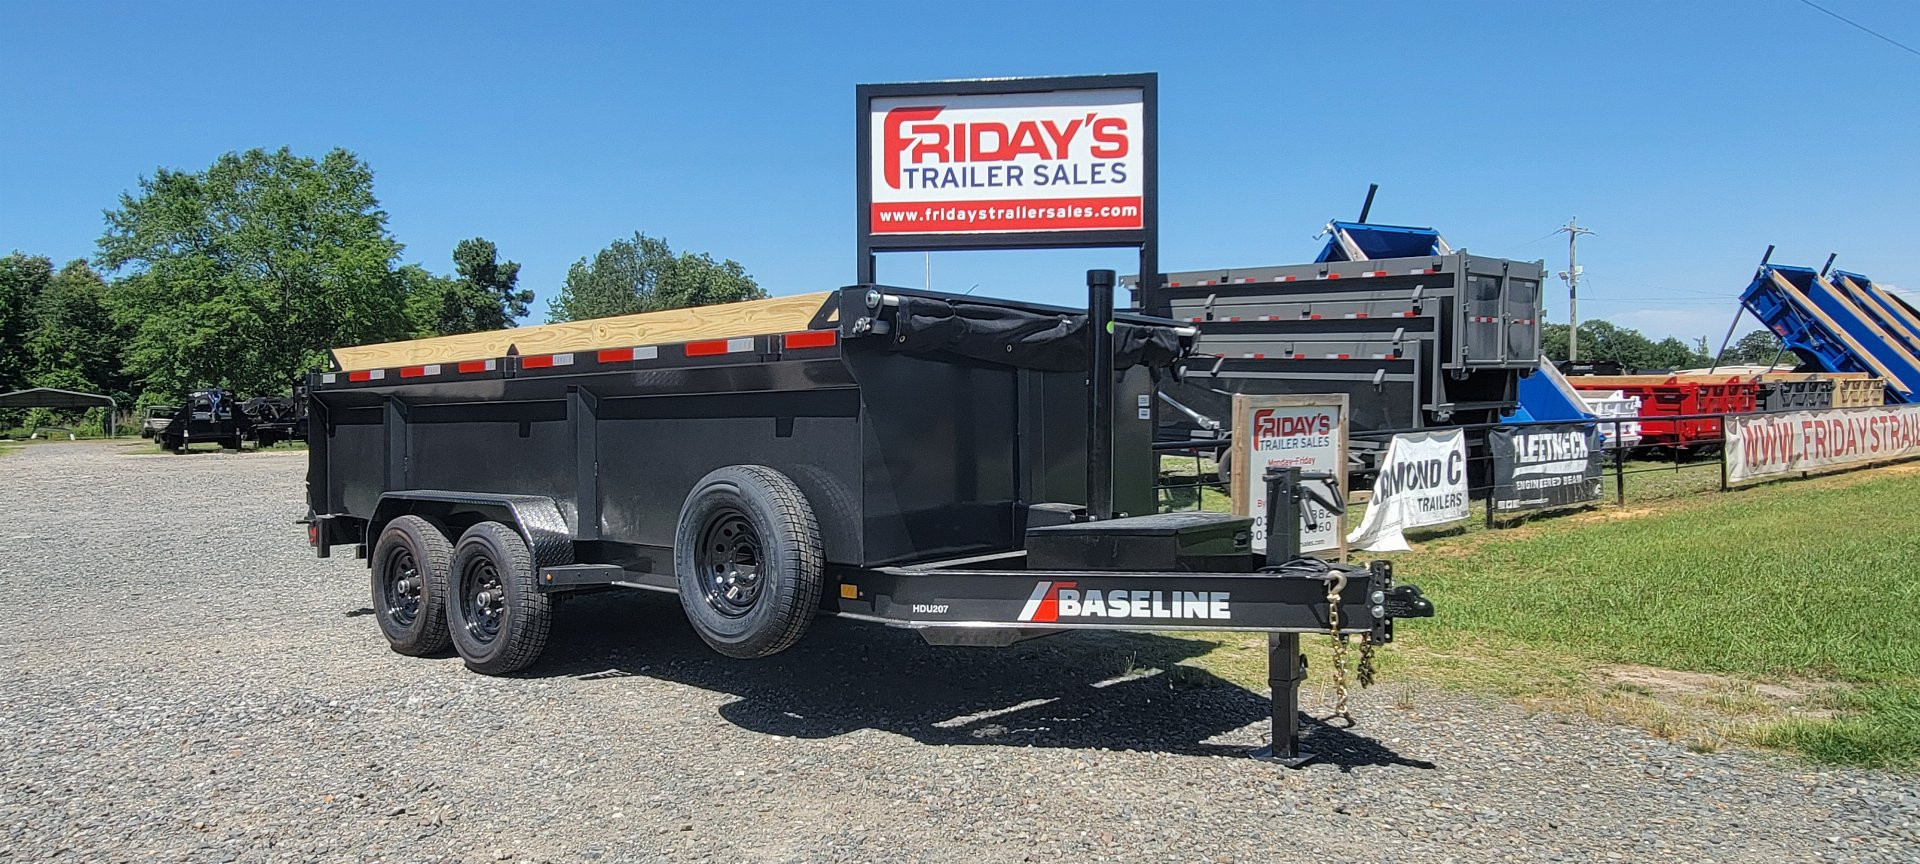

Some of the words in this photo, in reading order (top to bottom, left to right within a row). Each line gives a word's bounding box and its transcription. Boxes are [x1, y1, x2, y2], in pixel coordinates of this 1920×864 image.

[884, 106, 1129, 189] FRIDAY'S
[904, 165, 1024, 189] TRAILER
[1033, 162, 1127, 186] SALES
[880, 205, 1138, 222] www.fridaystrailersales.com
[1254, 409, 1330, 451] FRIDAY'S
[1260, 438, 1299, 451] TRAILER
[1300, 436, 1330, 448] SALES
[1447, 450, 1462, 486] C
[1418, 492, 1462, 513] TRAILERS
[912, 603, 949, 615] HDU207
[1058, 588, 1231, 620] BASELINE
